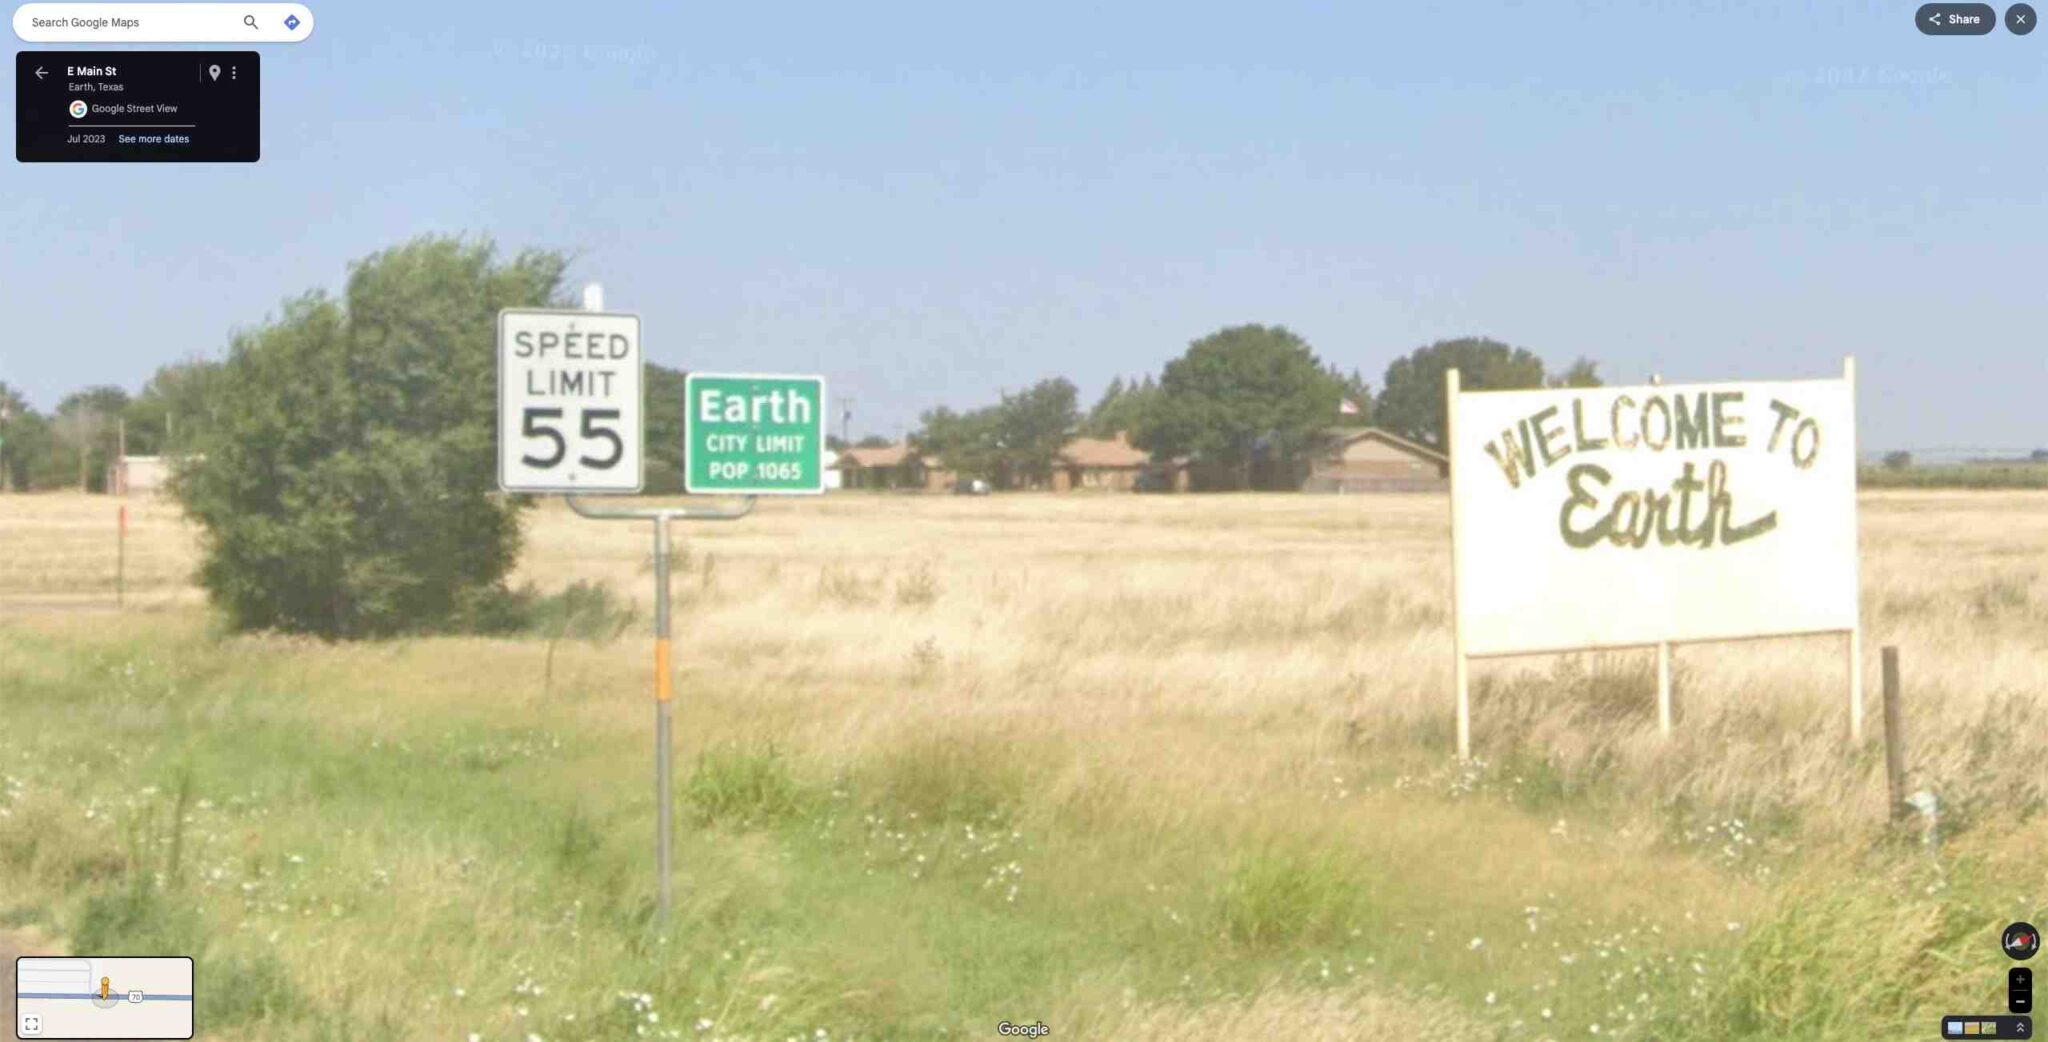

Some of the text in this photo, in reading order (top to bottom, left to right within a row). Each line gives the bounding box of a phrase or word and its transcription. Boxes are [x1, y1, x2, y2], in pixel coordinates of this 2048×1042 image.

[514, 331, 629, 360] SPEED
[527, 370, 616, 397] LIMIT
[701, 389, 811, 424] Earth
[521, 407, 623, 470] 55
[706, 433, 804, 453] CITY LIMIT
[1484, 391, 1820, 489] WELCOME TO
[710, 462, 802, 480] POP 1065
[1559, 459, 1777, 550] Earth
